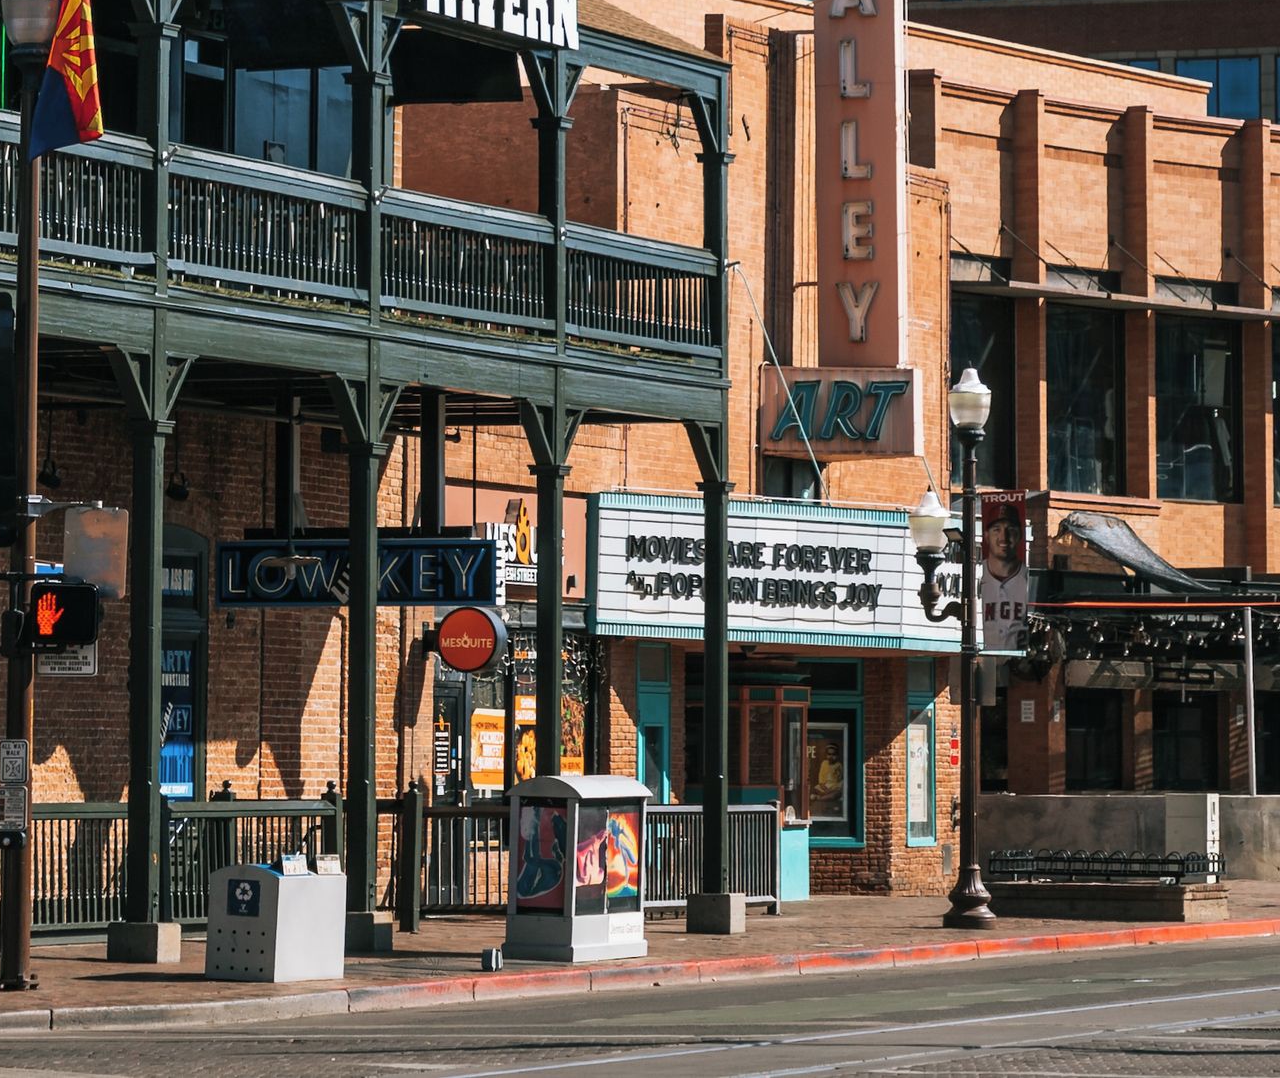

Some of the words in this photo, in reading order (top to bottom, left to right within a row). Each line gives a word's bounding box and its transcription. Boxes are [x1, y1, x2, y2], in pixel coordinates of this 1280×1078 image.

[771, 378, 910, 442] ART
[982, 493, 1024, 503] TROUT
[625, 534, 706, 568] MOVIES
[726, 539, 766, 570] ARE
[772, 542, 873, 576] FOREVER
[222, 547, 344, 599] LOW
[376, 547, 487, 599] KEY
[655, 572, 760, 606] POPRN
[761, 579, 838, 611] BRINGS
[838, 582, 882, 612] JOY
[984, 601, 1024, 623] NGE
[441, 635, 493, 649] MESQUITE
[161, 650, 192, 672] ARTY
